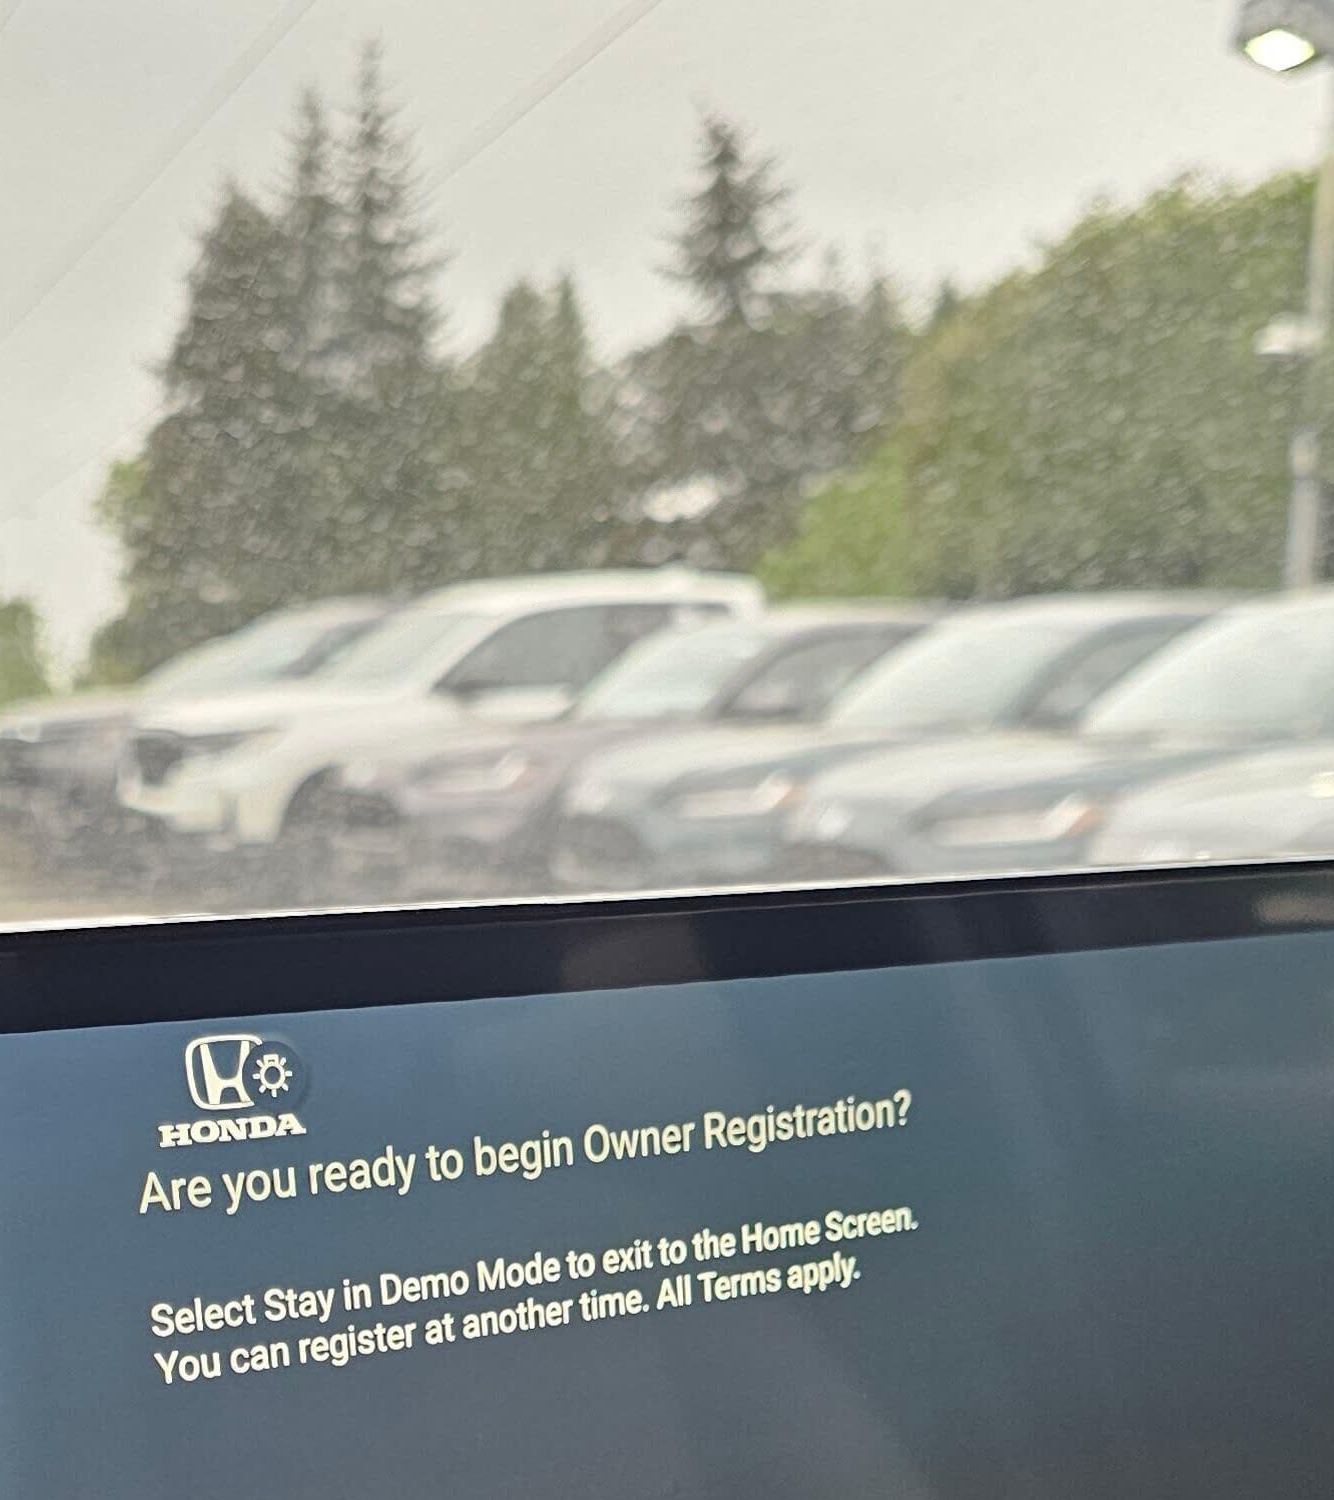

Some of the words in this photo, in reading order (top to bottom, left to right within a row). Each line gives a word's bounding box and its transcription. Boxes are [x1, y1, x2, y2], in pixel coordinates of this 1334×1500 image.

[140, 1172, 211, 1213] Are
[222, 1167, 296, 1215] you
[309, 1145, 416, 1195] ready
[425, 1146, 463, 1181] to
[474, 1130, 573, 1180] begin
[584, 1122, 695, 1162] Owner
[704, 1089, 911, 1152] Registration?
[158, 1113, 306, 1147] HONDA
[151, 1294, 256, 1337] Select
[264, 1288, 335, 1323] Stay
[343, 1279, 372, 1310] in
[380, 1270, 469, 1305] Demo
[477, 1252, 560, 1292] Mode
[566, 1250, 595, 1279] to
[603, 1239, 653, 1274] exit
[657, 1238, 687, 1266] to
[691, 1228, 736, 1261] the
[741, 1221, 821, 1254] Home
[825, 1207, 918, 1241] Screen.
[154, 1350, 221, 1384] You
[230, 1342, 290, 1373] can
[299, 1323, 416, 1366] register
[425, 1313, 455, 1344] at
[463, 1297, 573, 1339] another
[579, 1289, 649, 1321] time.
[657, 1274, 692, 1310] All
[697, 1268, 781, 1302] Terms
[787, 1251, 860, 1294] apply.
